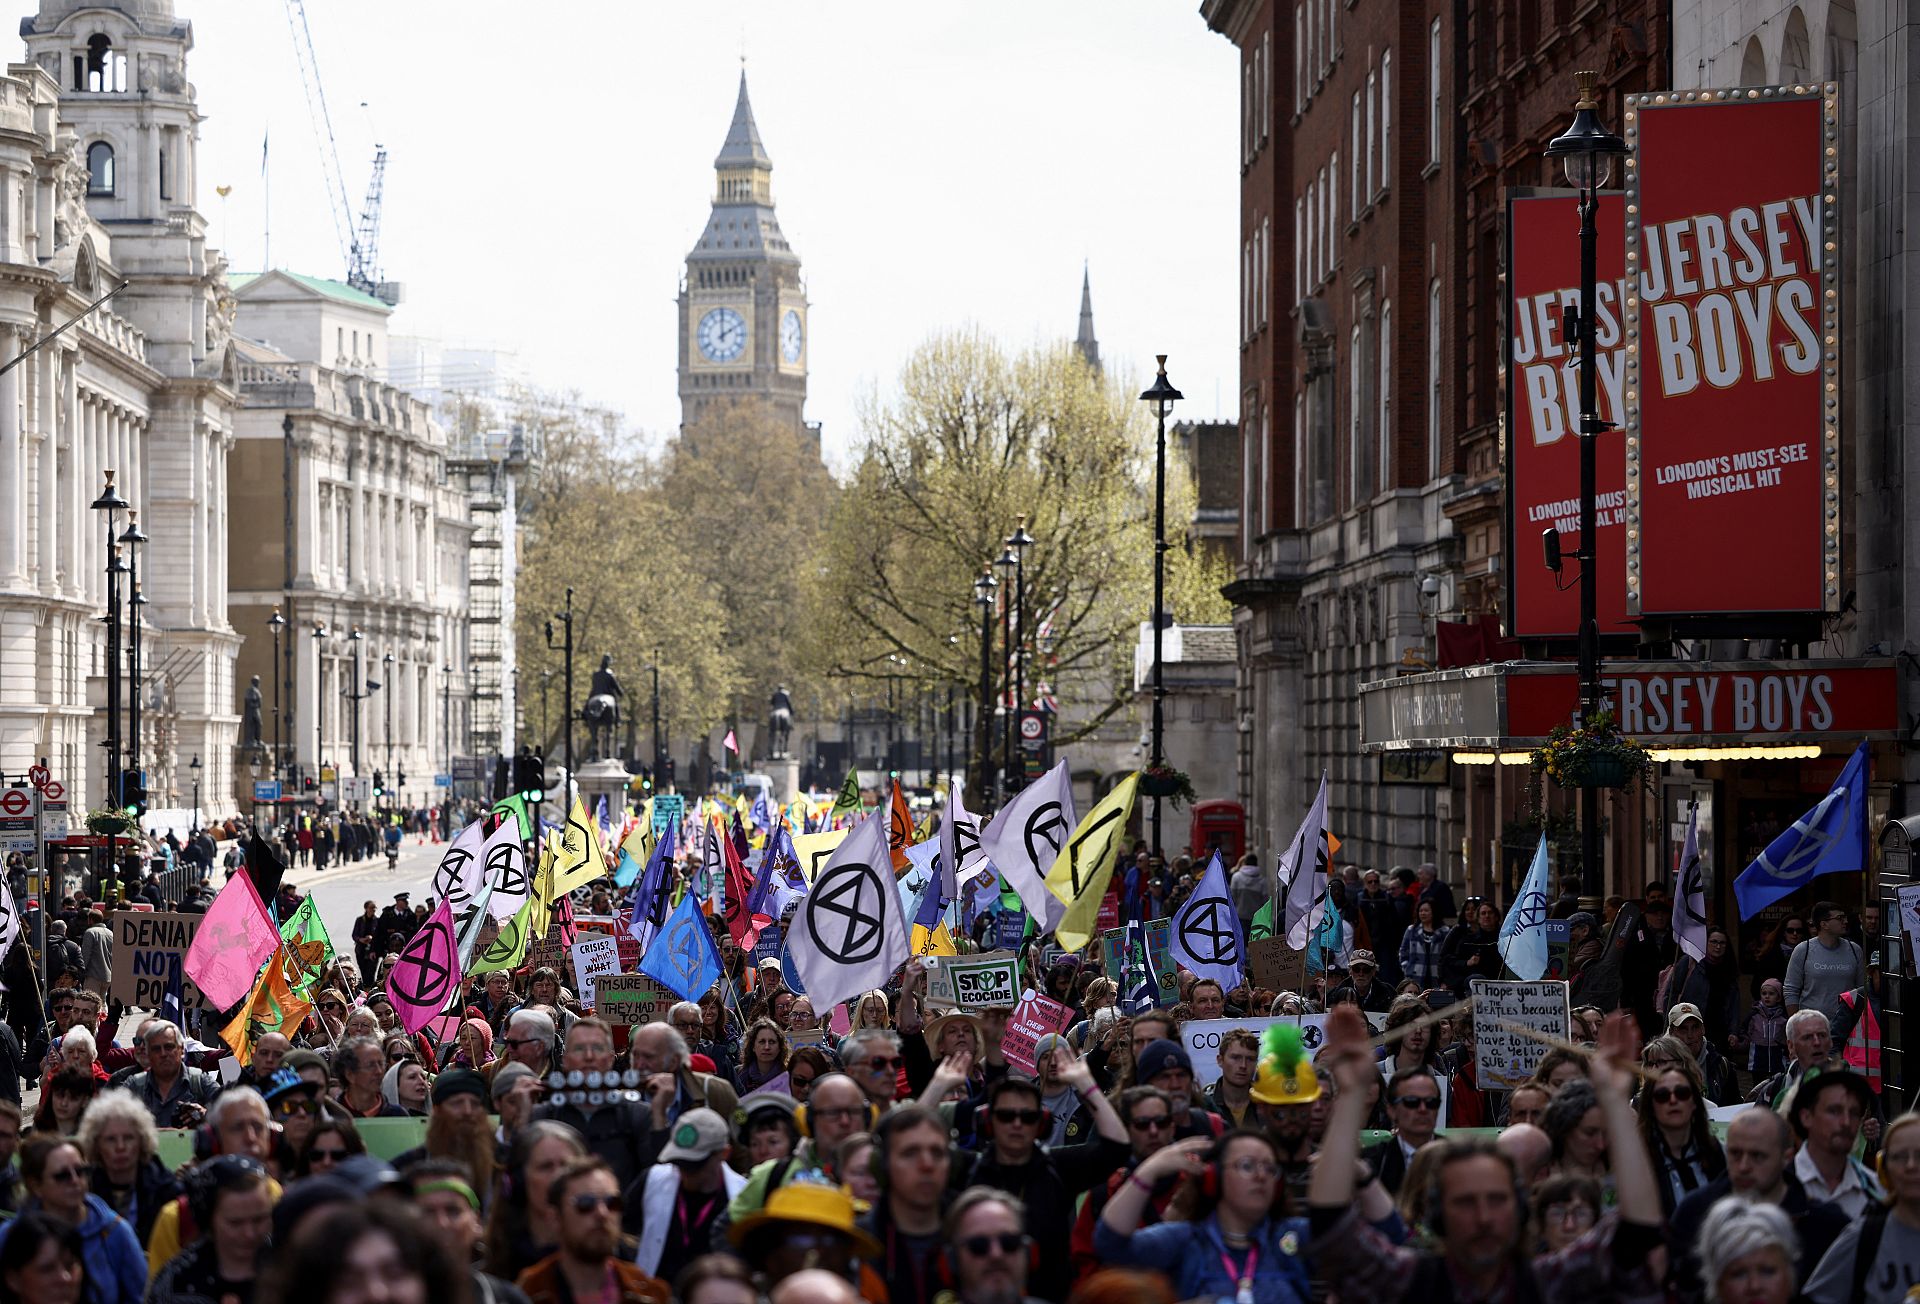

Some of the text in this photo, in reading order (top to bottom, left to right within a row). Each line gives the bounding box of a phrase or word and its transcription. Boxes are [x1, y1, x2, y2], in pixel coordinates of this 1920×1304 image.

[1641, 195, 1821, 301] JERSEY
[1652, 279, 1821, 398] BOYS
[1656, 443, 1808, 486] LONDON'S MUST-SEE
[1687, 467, 1782, 499] MUSICAL HIT
[1573, 674, 1834, 733] ERSEY BOYS
[1024, 722, 1038, 732] 20
[1552, 924, 1565, 932] TO
[579, 940, 609, 955] CRISIS?
[755, 942, 778, 950] NSULATE
[590, 948, 617, 964] which
[612, 977, 641, 991] SURE
[961, 989, 1012, 1003] ECOCIDE
[1473, 983, 1482, 996] I
[1485, 984, 1513, 1000] hope
[1517, 986, 1538, 1002] you
[602, 1002, 633, 1014] THEY
[634, 1002, 655, 1014] HAD
[1476, 1003, 1564, 1018] BEATLES because
[619, 1011, 650, 1024] TOO
[1540, 1020, 1561, 1034] all
[1476, 1033, 1505, 1046] have
[1509, 1034, 1521, 1046] to
